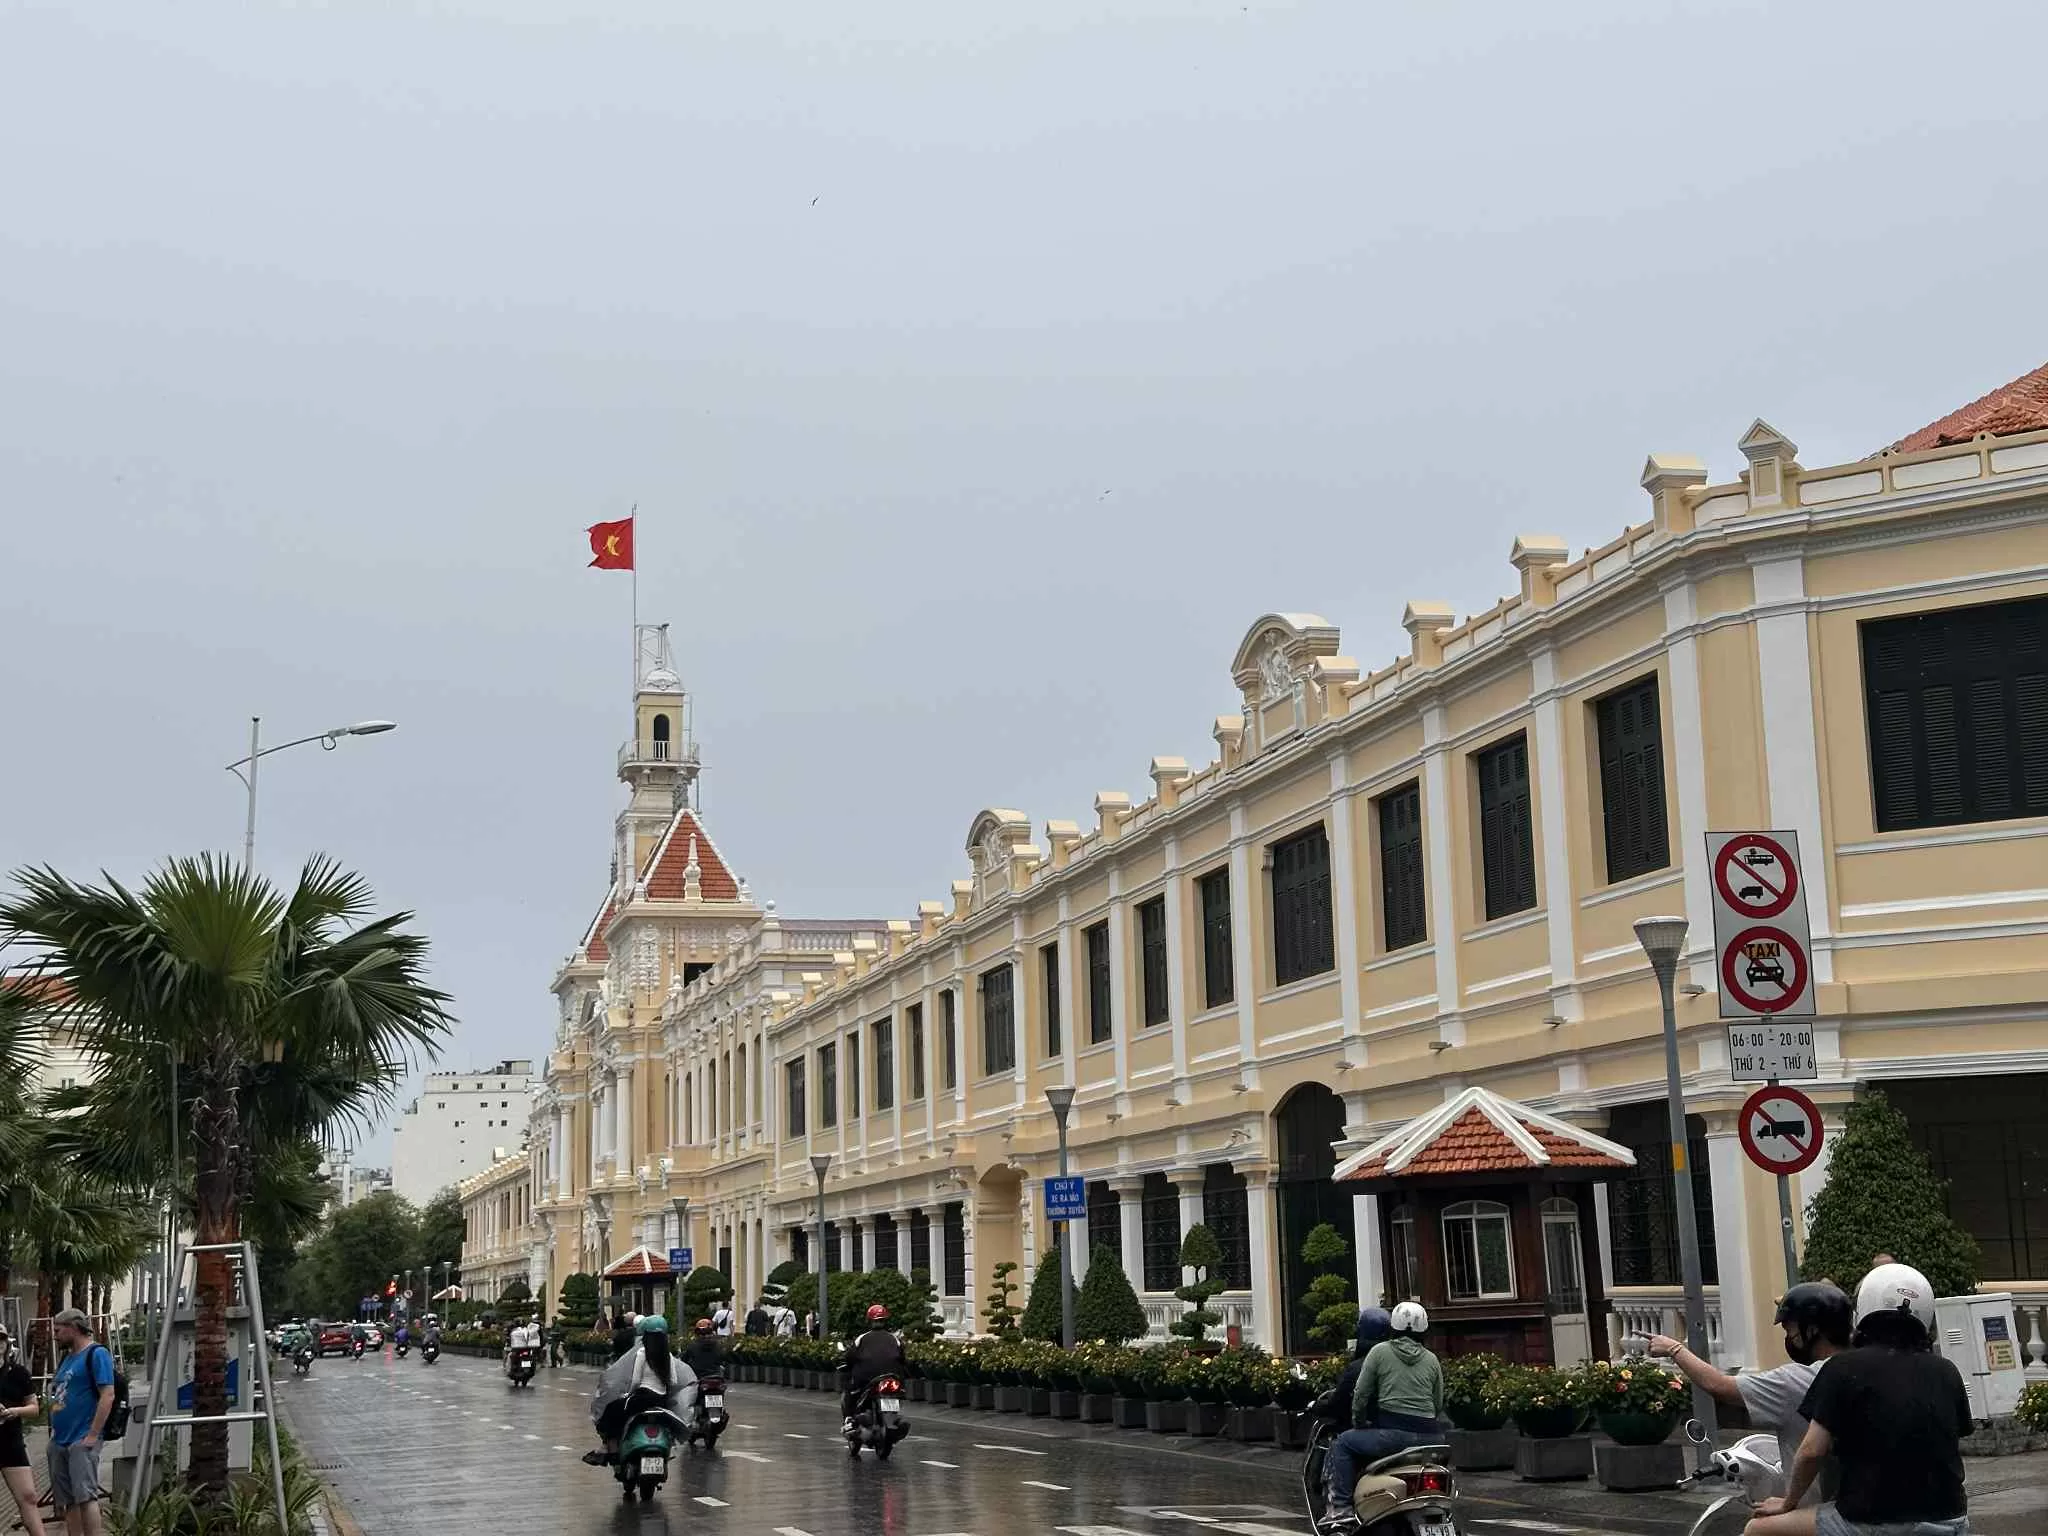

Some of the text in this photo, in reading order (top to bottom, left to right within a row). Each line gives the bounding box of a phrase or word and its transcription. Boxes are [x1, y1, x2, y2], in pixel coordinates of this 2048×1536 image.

[1746, 943, 1780, 957] TAXI
[1732, 1033, 1763, 1047] 06:00
[1780, 1032, 1810, 1046] 20:00
[1759, 1057, 1765, 1070] 2
[1807, 1056, 1813, 1069] 6
